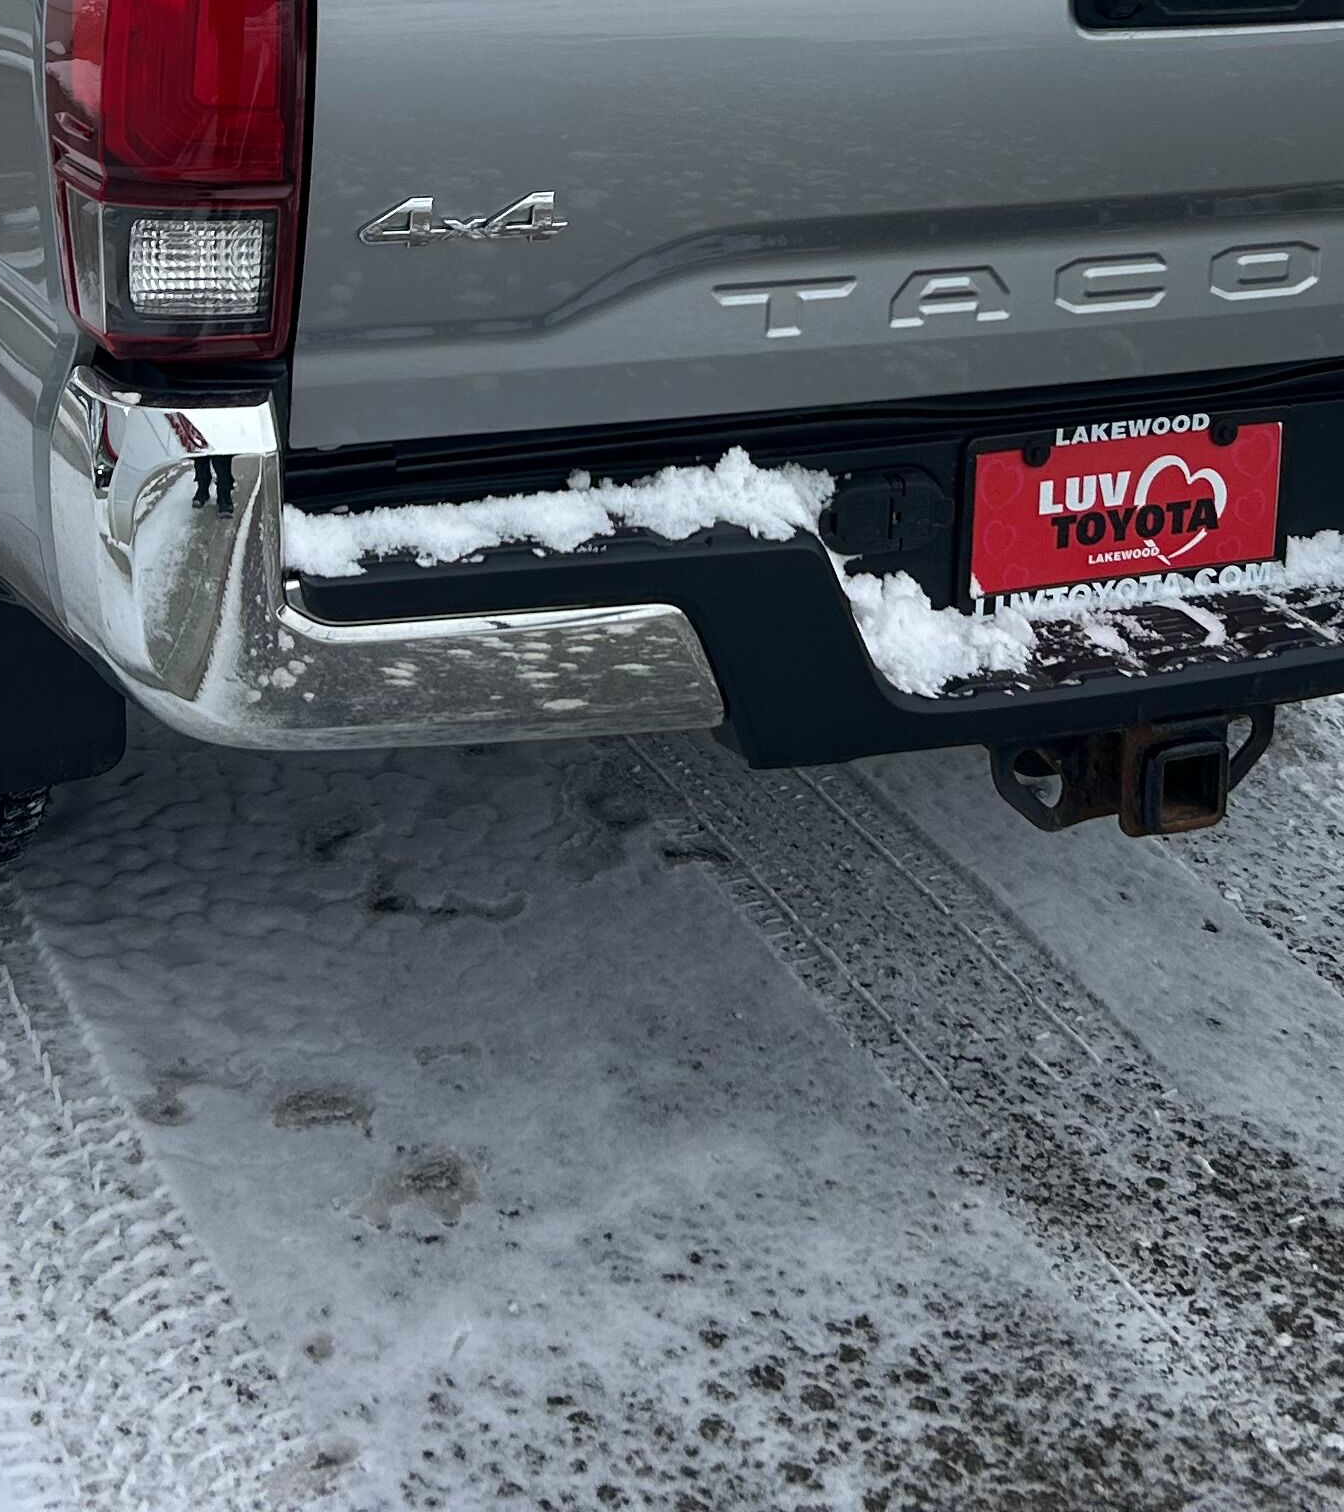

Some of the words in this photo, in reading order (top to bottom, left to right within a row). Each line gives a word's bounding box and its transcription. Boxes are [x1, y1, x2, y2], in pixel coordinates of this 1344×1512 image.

[1054, 412, 1211, 447] LAKEWOOD
[1038, 470, 1132, 516] LUV
[1051, 498, 1219, 549] TOYOTA
[1087, 545, 1160, 565] LAKEWOOD
[974, 562, 1275, 619] LUVTOYOTACOM
